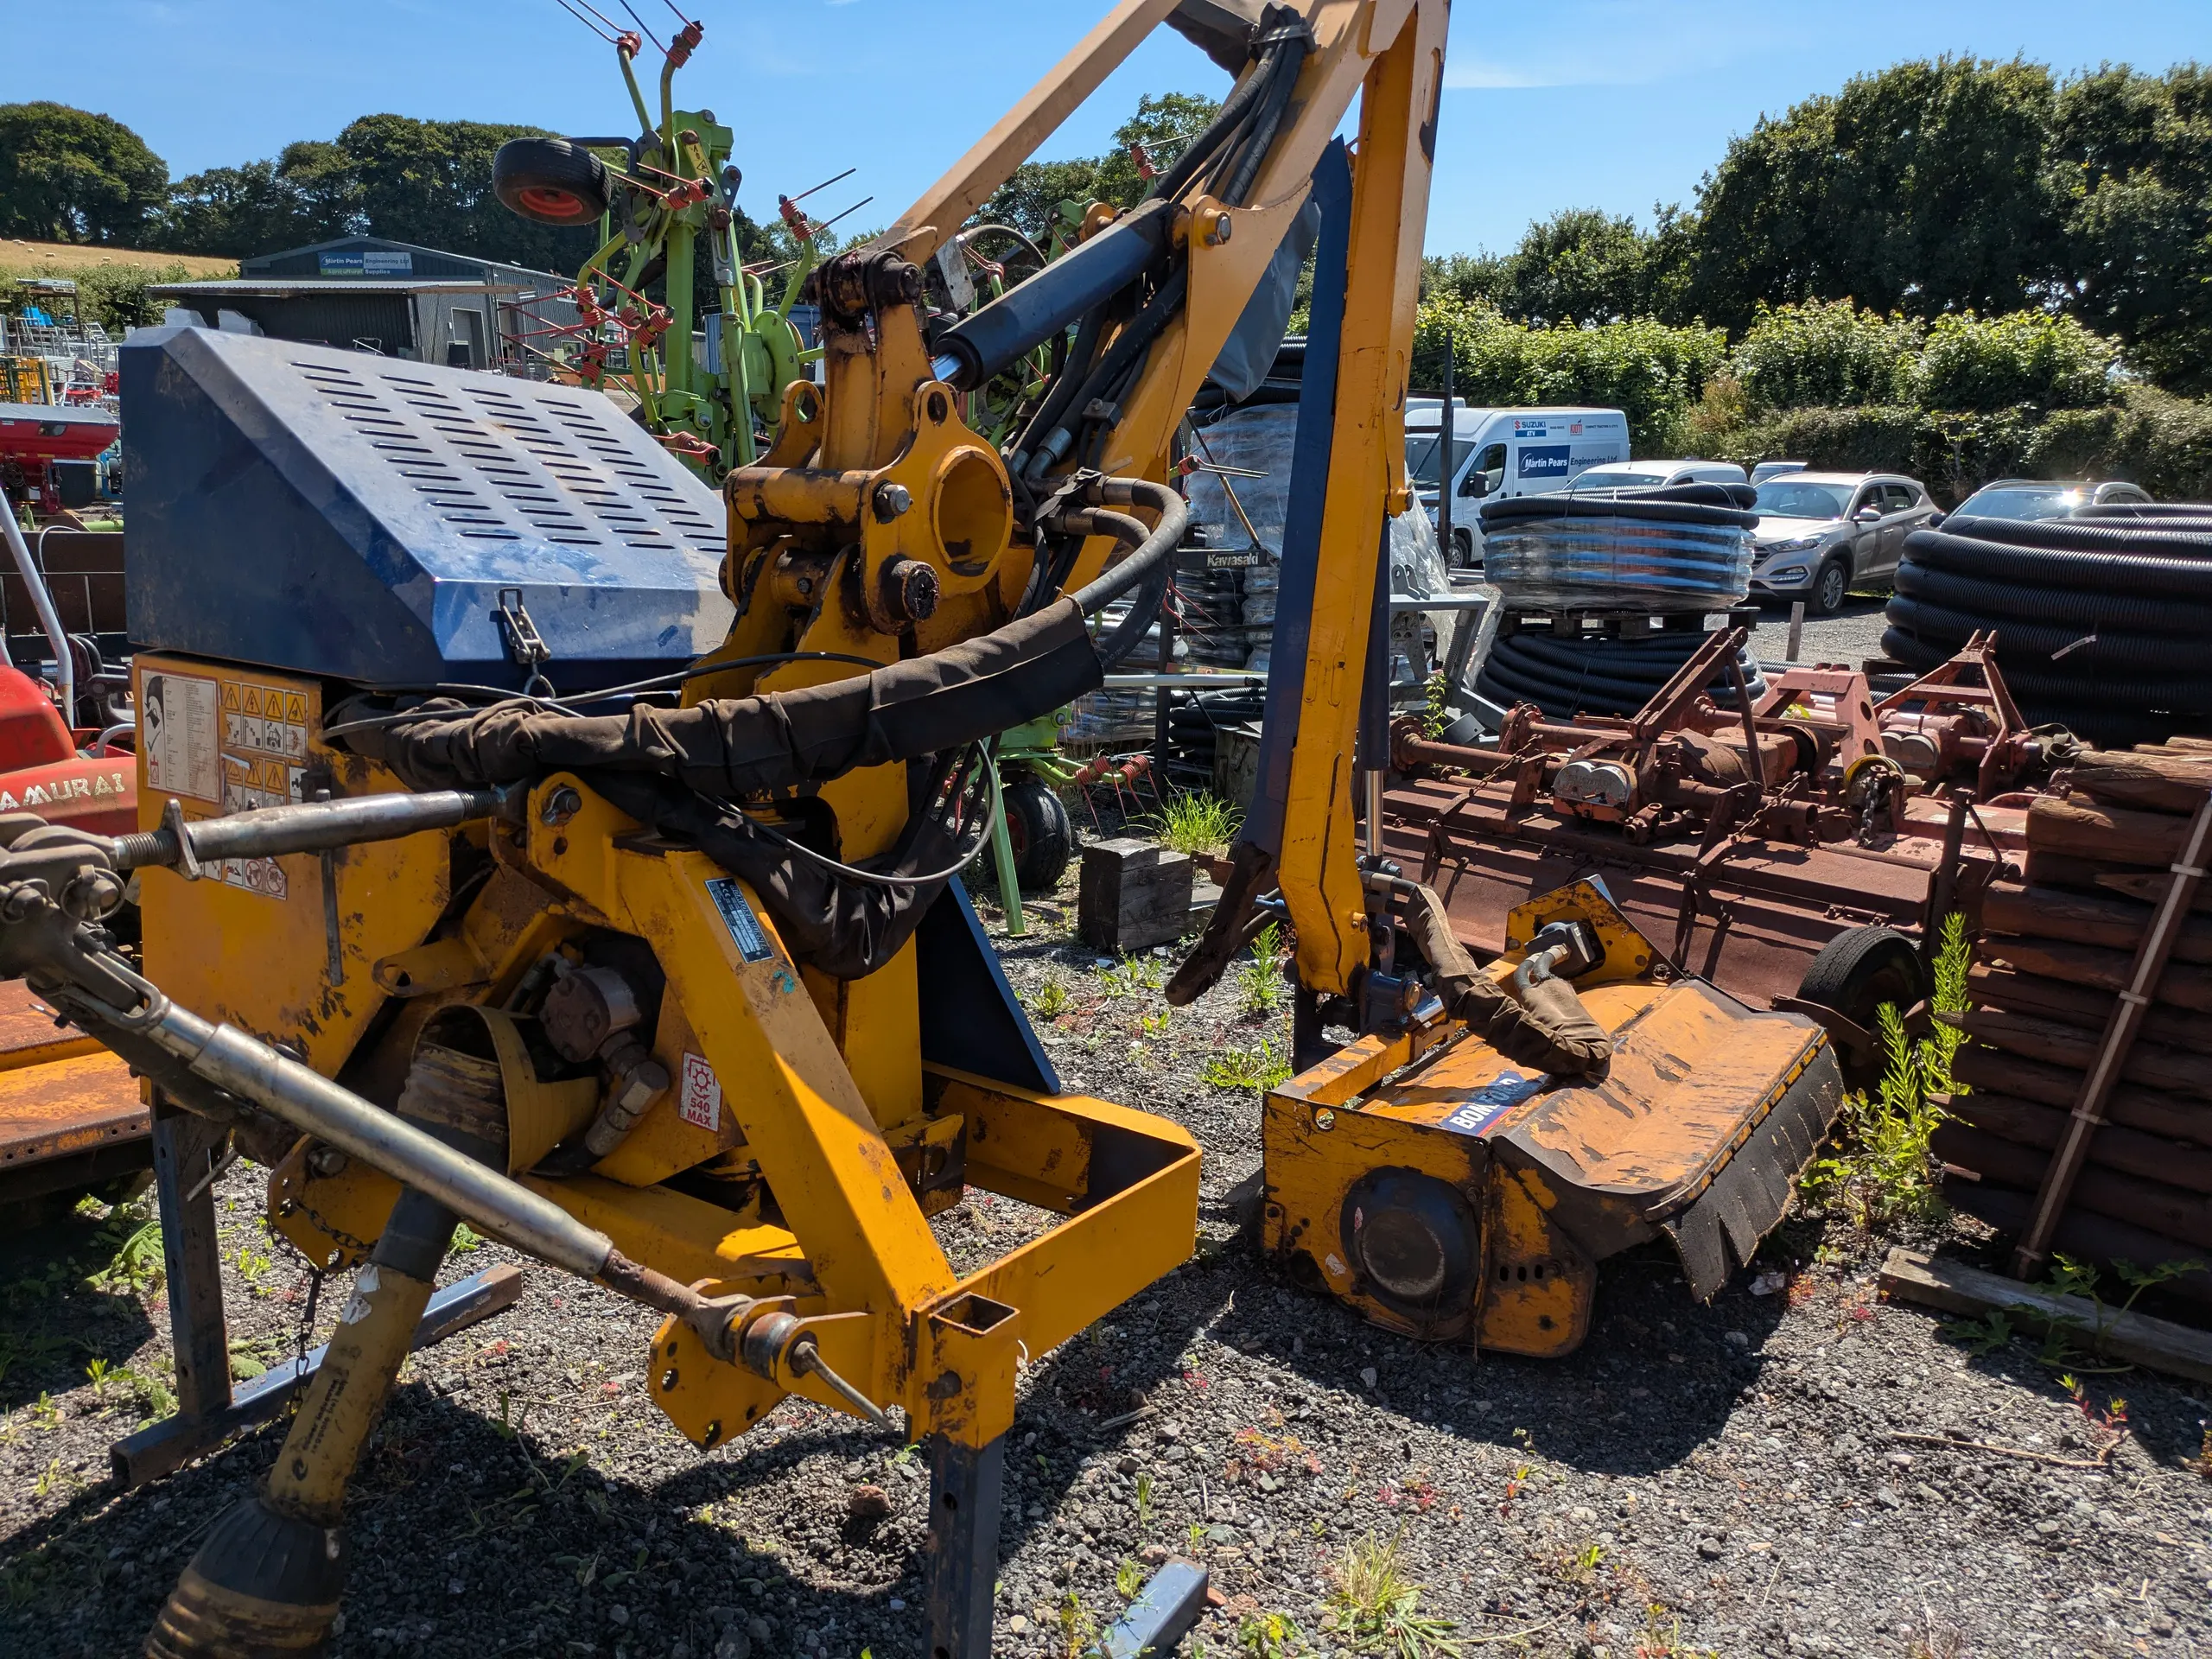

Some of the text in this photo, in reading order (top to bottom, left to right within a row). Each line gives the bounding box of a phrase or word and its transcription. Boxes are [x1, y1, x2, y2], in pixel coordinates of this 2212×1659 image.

[1525, 455, 1618, 468] Martin Pears Engineering Ltd
[1207, 552, 1259, 567] Kawasaki
[690, 1098, 710, 1114] 540
[687, 1109, 712, 1128] MAX
